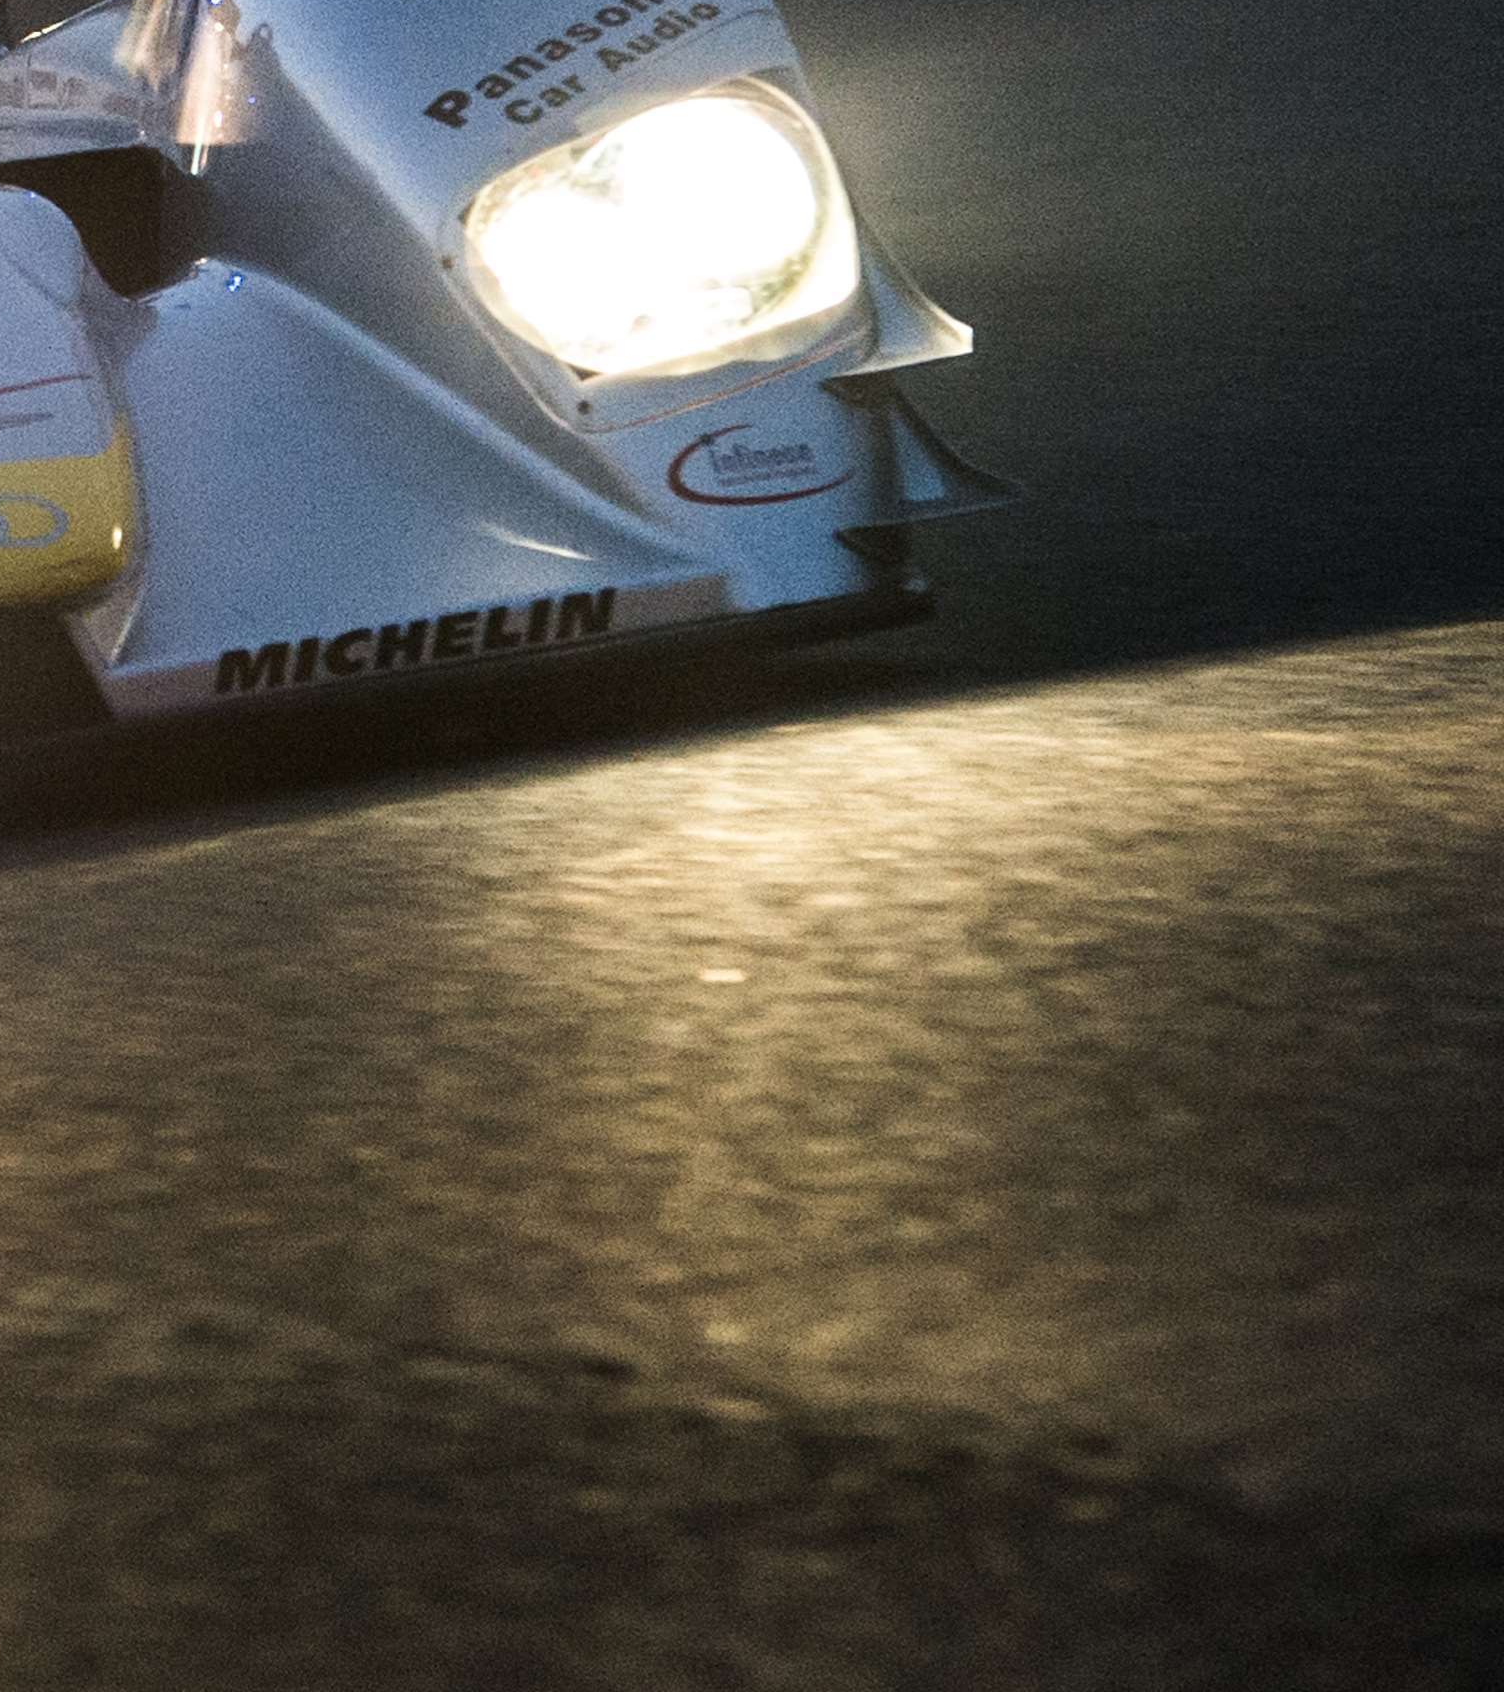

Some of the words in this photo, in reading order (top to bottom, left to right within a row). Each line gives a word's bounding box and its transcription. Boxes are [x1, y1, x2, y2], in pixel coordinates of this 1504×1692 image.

[504, 74, 585, 124] Car
[597, 3, 720, 72] Audio
[214, 587, 617, 695] MICHELIN
